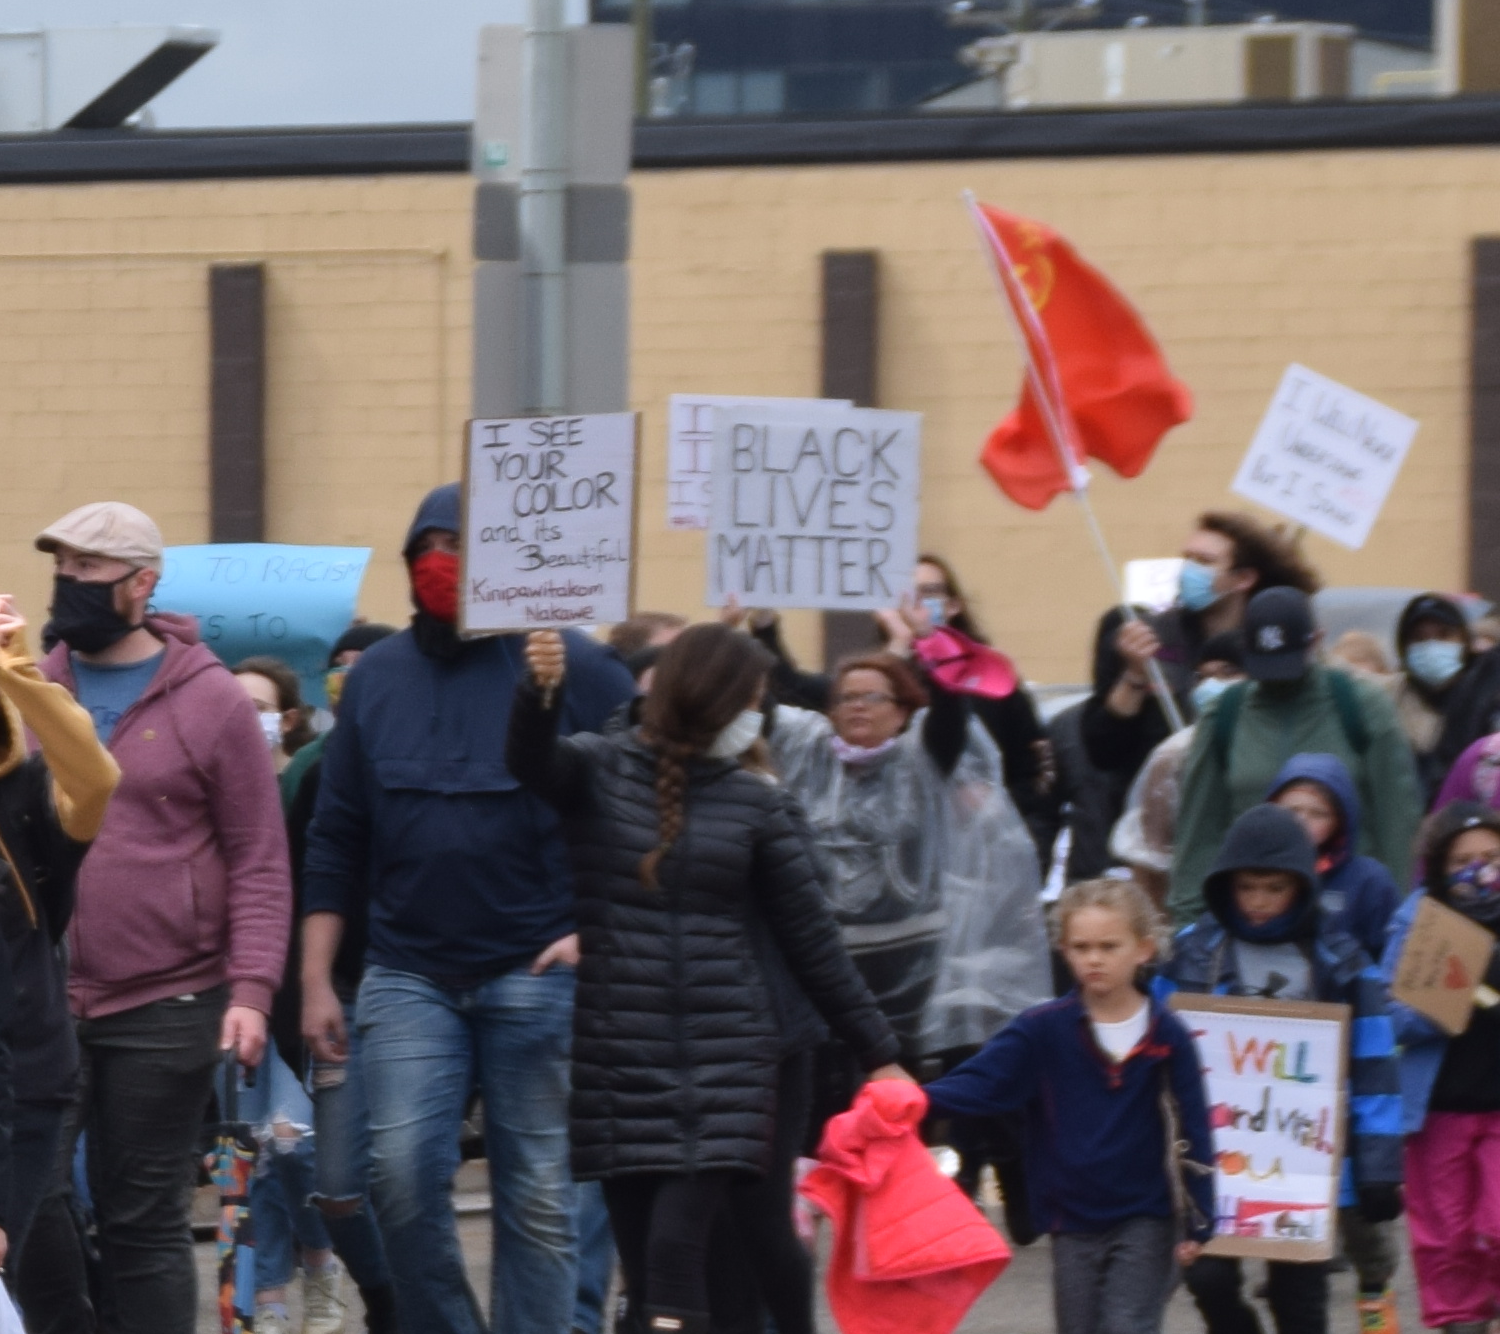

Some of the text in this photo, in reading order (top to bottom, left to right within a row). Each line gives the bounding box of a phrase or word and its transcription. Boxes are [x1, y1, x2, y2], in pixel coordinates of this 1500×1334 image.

[481, 418, 585, 448] I SEE
[732, 422, 902, 479] BLACK
[490, 449, 569, 482] YOUR
[512, 471, 620, 518] COLOR
[734, 476, 897, 532] LIVES
[480, 517, 563, 544] and its
[206, 556, 247, 584] TO
[716, 532, 892, 598] MATTER
